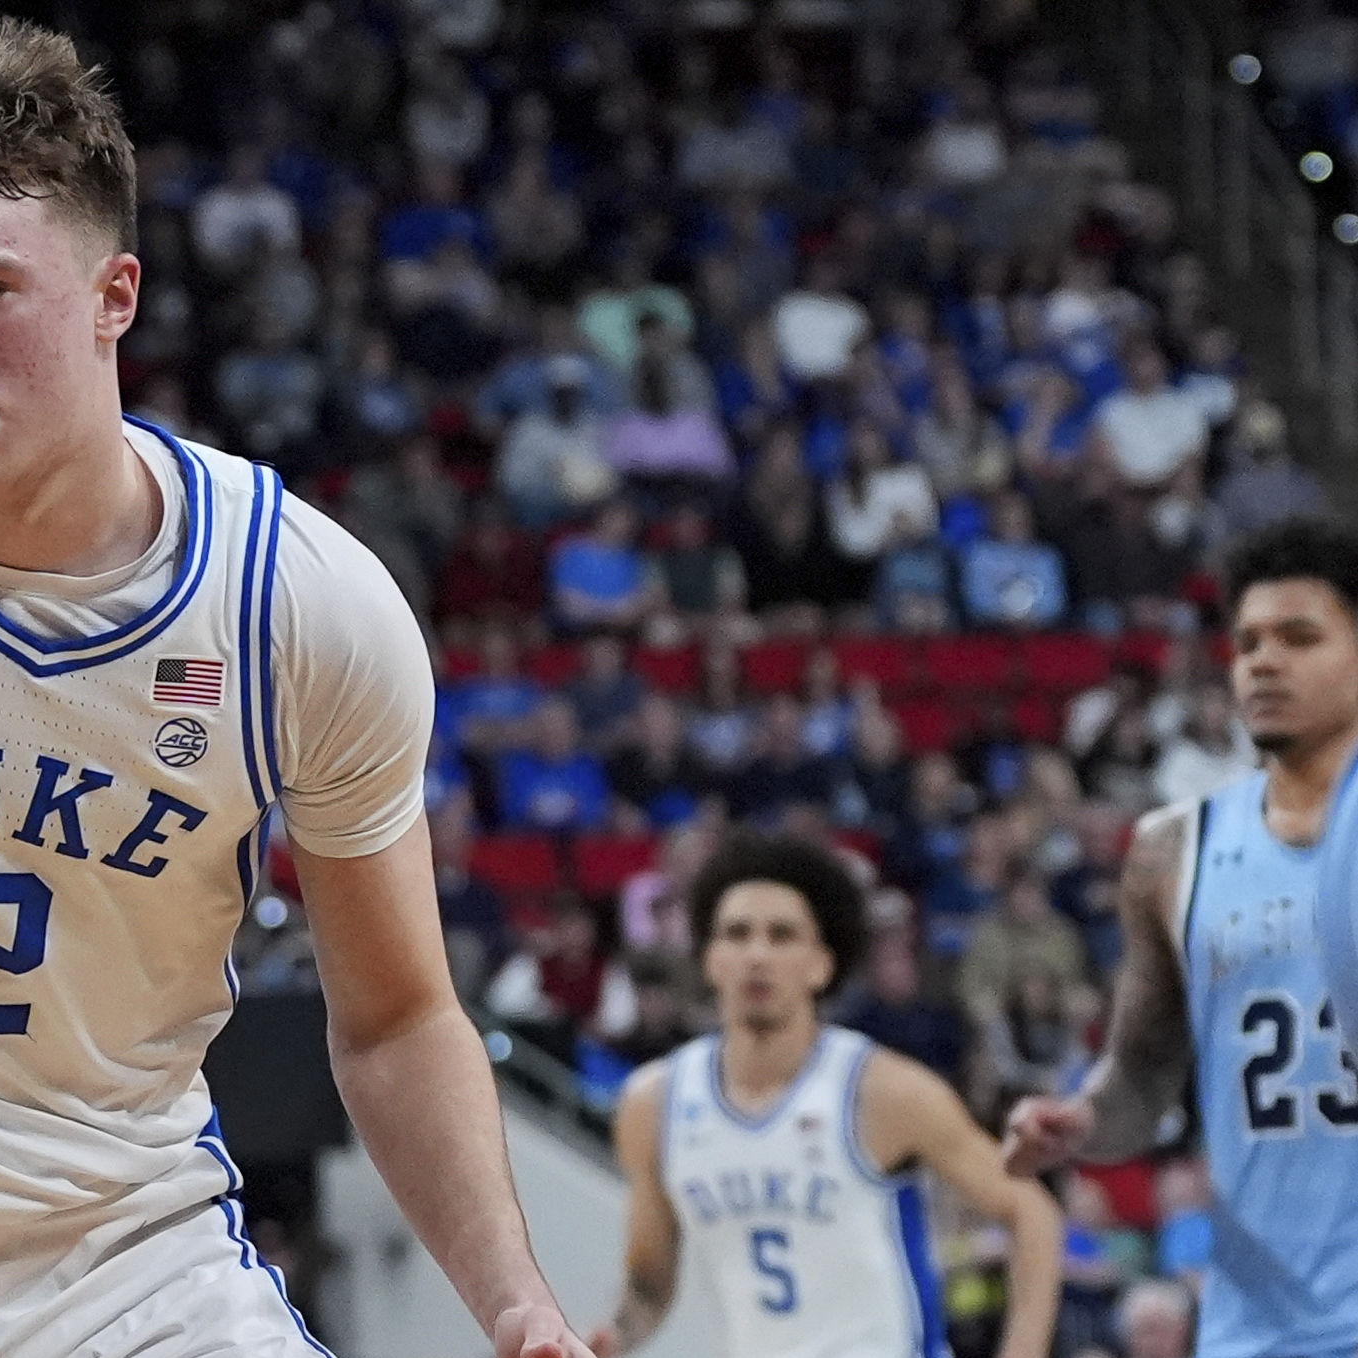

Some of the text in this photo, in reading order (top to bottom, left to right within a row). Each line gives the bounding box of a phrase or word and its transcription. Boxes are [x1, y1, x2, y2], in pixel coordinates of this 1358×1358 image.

[161, 733, 207, 748] ACC
[683, 1170, 842, 1226] DUKE
[747, 1226, 799, 1316] 5
